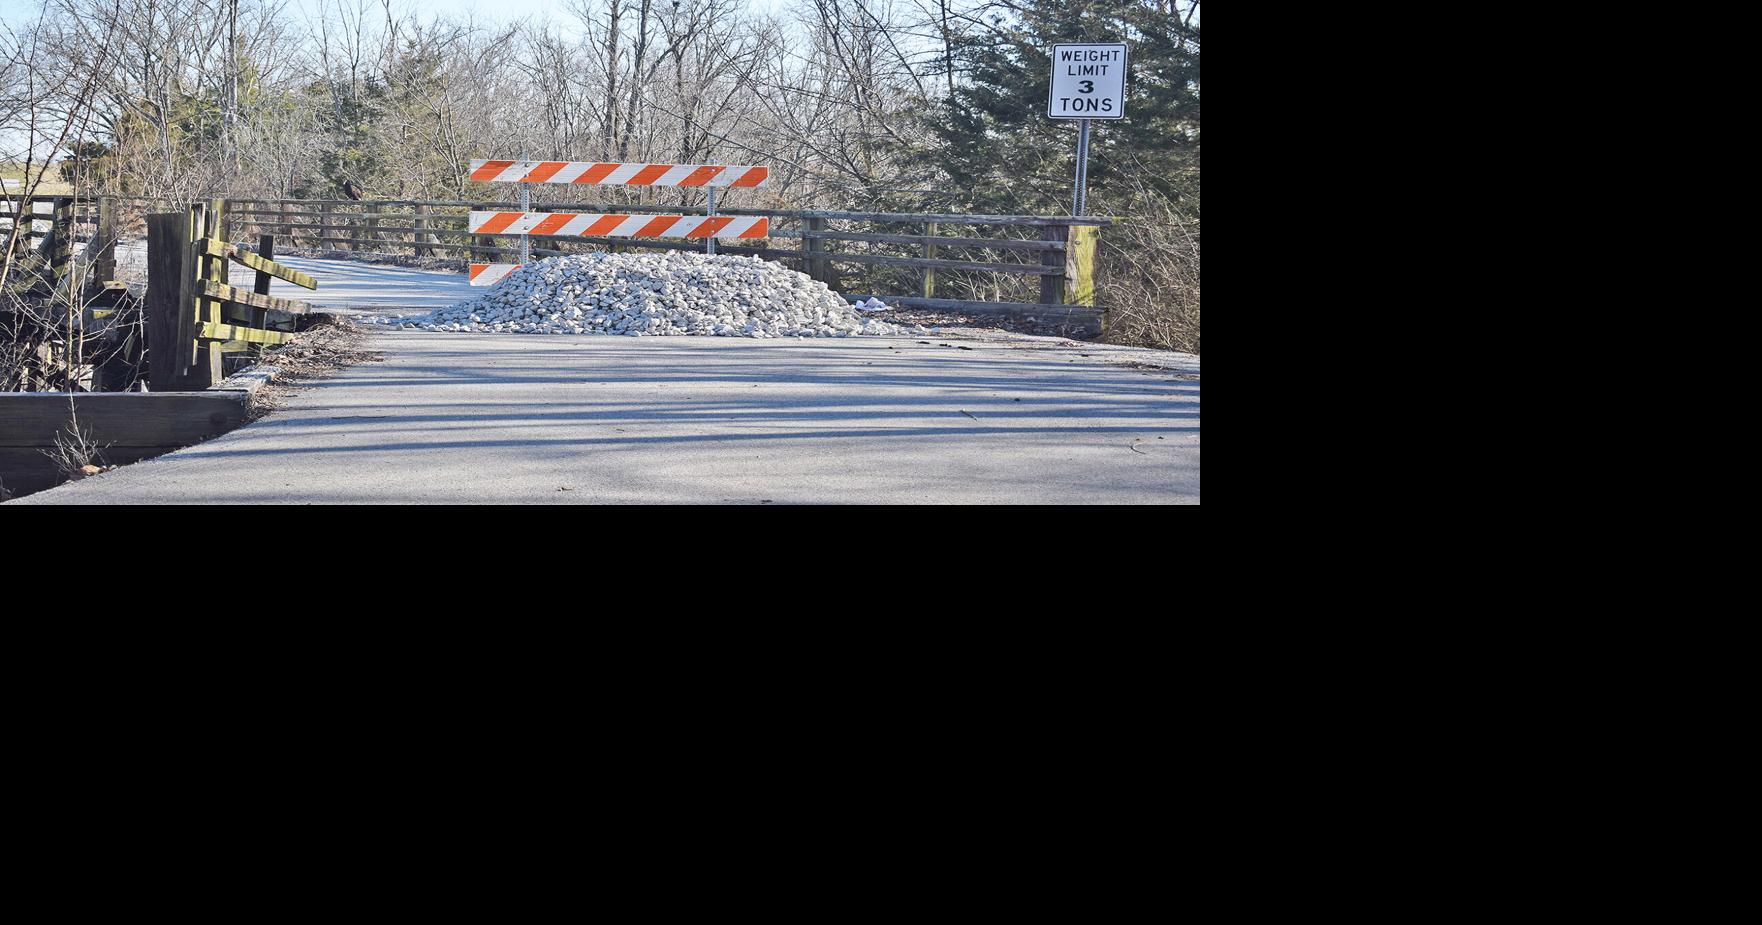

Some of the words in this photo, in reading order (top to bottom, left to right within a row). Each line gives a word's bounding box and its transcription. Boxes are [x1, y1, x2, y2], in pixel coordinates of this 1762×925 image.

[1061, 50, 1120, 61] WEIGHT
[1068, 65, 1109, 76] LIMIT
[1078, 80, 1094, 93] 3
[1060, 98, 1112, 111] TONS
